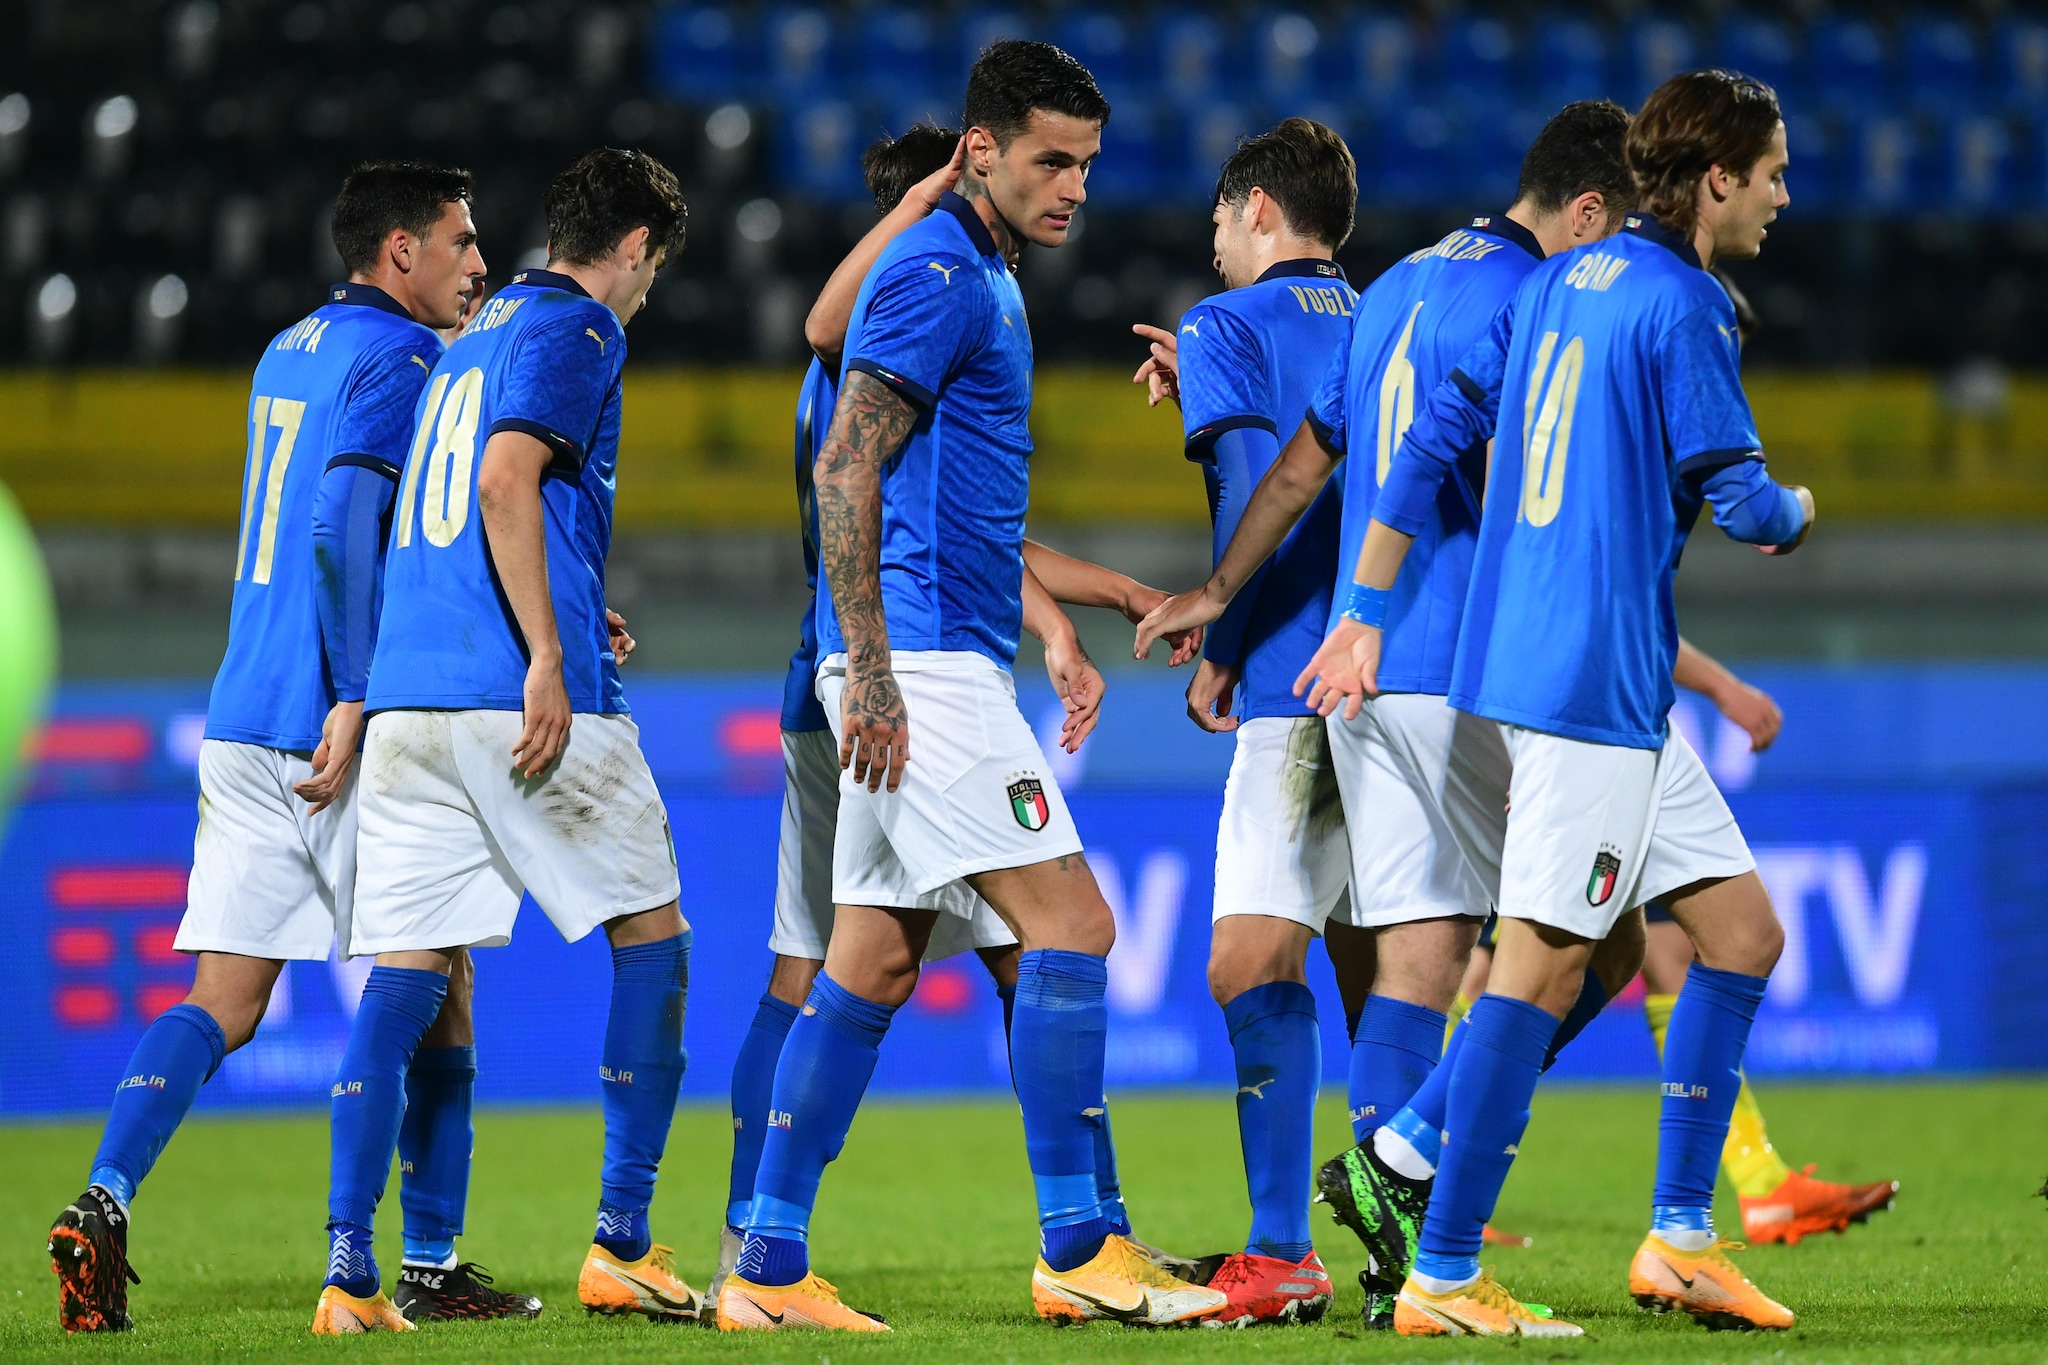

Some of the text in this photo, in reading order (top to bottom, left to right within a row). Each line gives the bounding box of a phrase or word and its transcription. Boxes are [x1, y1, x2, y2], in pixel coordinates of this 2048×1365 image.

[397, 367, 484, 549] 18
[1376, 301, 1424, 489] 6
[1516, 332, 1584, 527] 10
[235, 396, 307, 585] 17
[1010, 781, 1040, 796] ITALIA
[599, 1066, 634, 1083] ALIA
